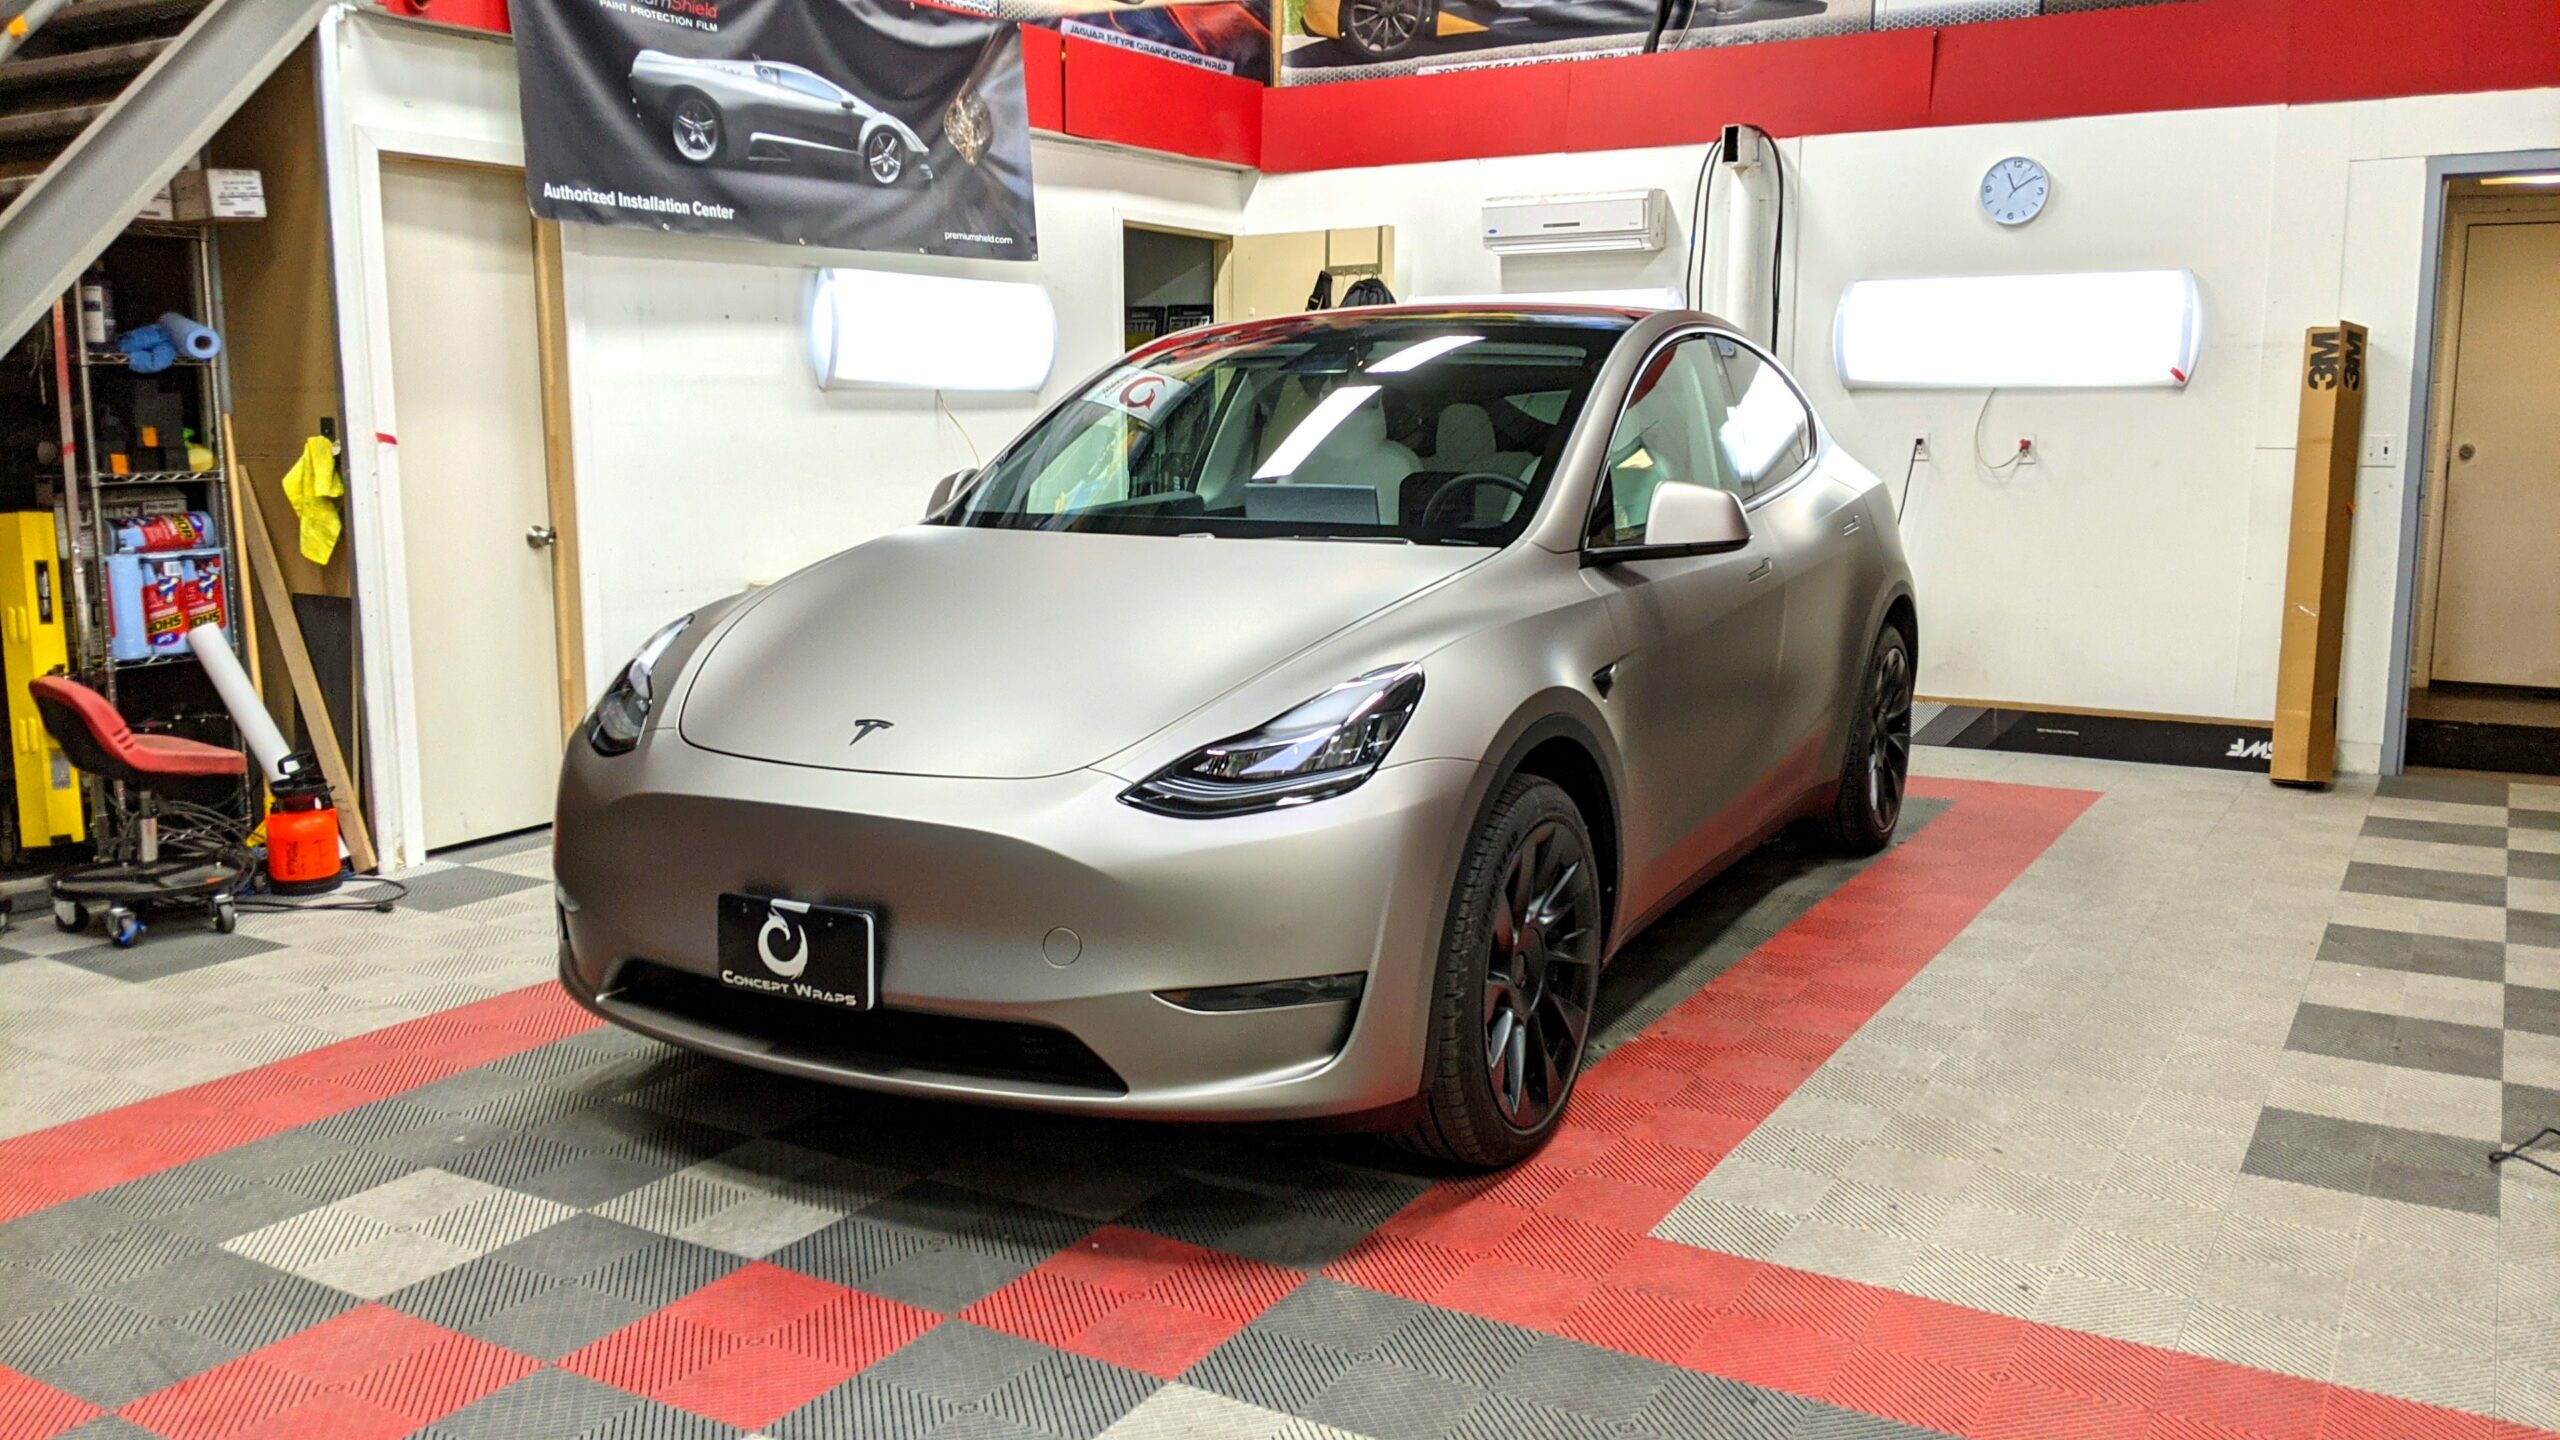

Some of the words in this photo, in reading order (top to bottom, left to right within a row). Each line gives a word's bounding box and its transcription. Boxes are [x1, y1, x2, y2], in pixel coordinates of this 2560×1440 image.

[599, 0, 628, 12] PAINT
[630, 5, 693, 28] PROTECTION
[696, 20, 719, 33] FILM
[1070, 24, 1105, 41] JAGUAR
[1136, 42, 1170, 58] ORANGE
[1171, 51, 1202, 66] CHROME
[1203, 59, 1228, 72] WRAP
[2014, 160, 2024, 168] 12
[543, 182, 616, 206] Authorized
[618, 191, 690, 215] Installation
[692, 201, 735, 220] Center
[1985, 185, 1992, 193] 9
[2036, 187, 2044, 196] 3
[2007, 212, 2014, 220] 6
[944, 231, 1013, 245] premiumshield.com
[2308, 332, 2340, 391] 3M
[2343, 330, 2363, 391] 3M
[721, 969, 790, 993] CONCEPT
[793, 982, 857, 1007] WRAPS
